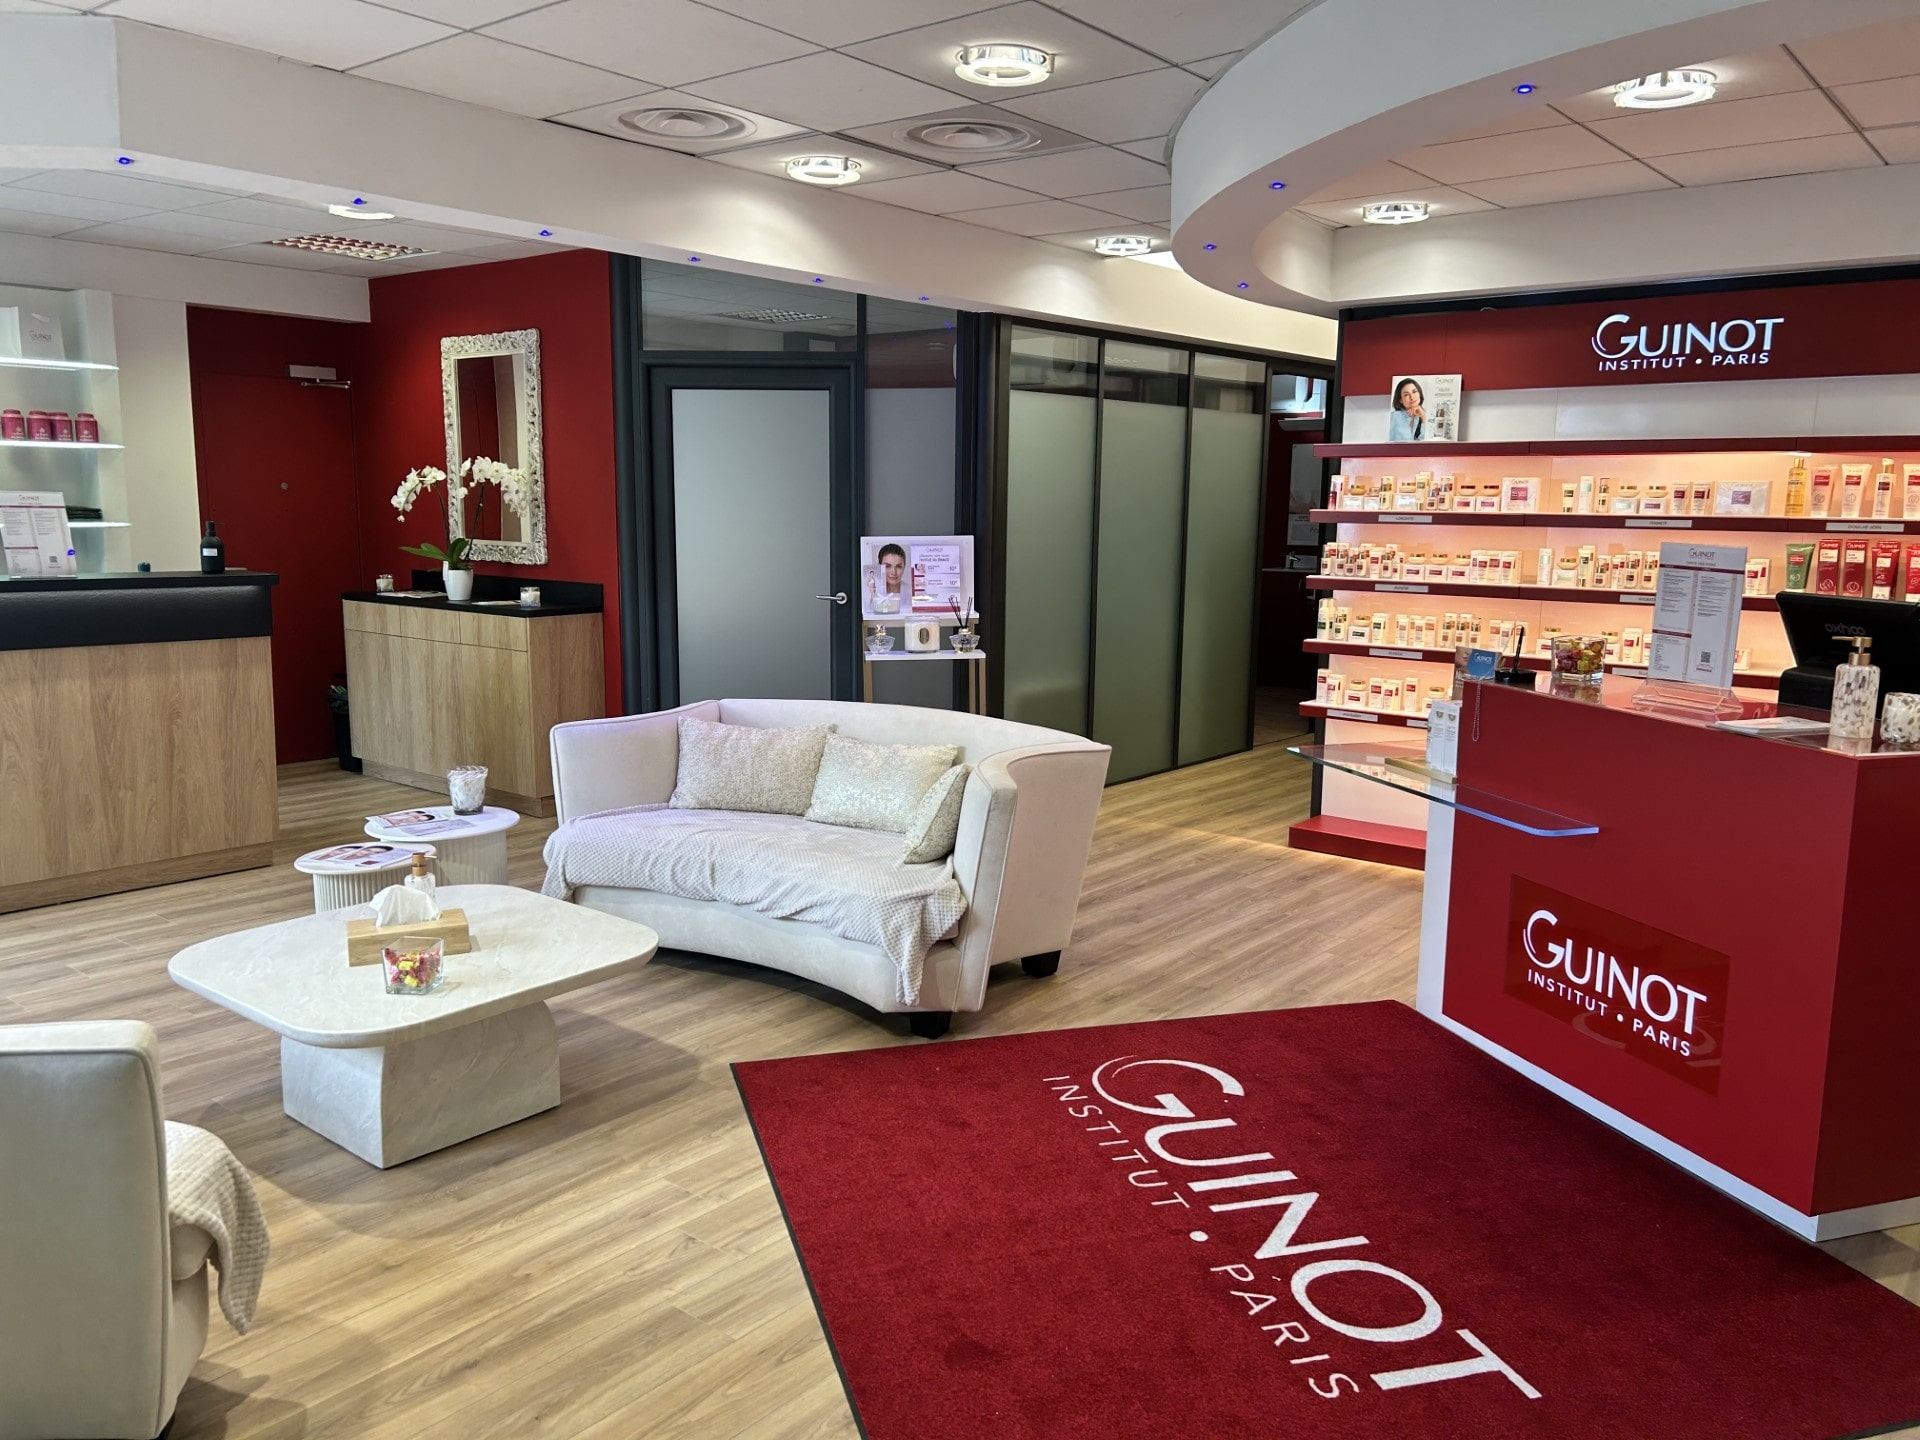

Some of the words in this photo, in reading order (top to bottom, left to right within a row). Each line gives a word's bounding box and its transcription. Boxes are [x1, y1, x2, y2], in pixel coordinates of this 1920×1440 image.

[1591, 313, 1785, 359] GUINOT
[1599, 356, 1686, 371] INSTITUT
[1711, 352, 1770, 366] PARIS
[1688, 547, 1716, 559] GUINOT
[1523, 909, 1708, 1036] GUINOT
[1527, 968, 1608, 1017] INSTITUT
[1632, 1018, 1690, 1057] PARIS
[1042, 1075, 1190, 1209] INSTITUT
[1210, 1263, 1360, 1399] PARIS
[1091, 1055, 1543, 1400] GUINOT
